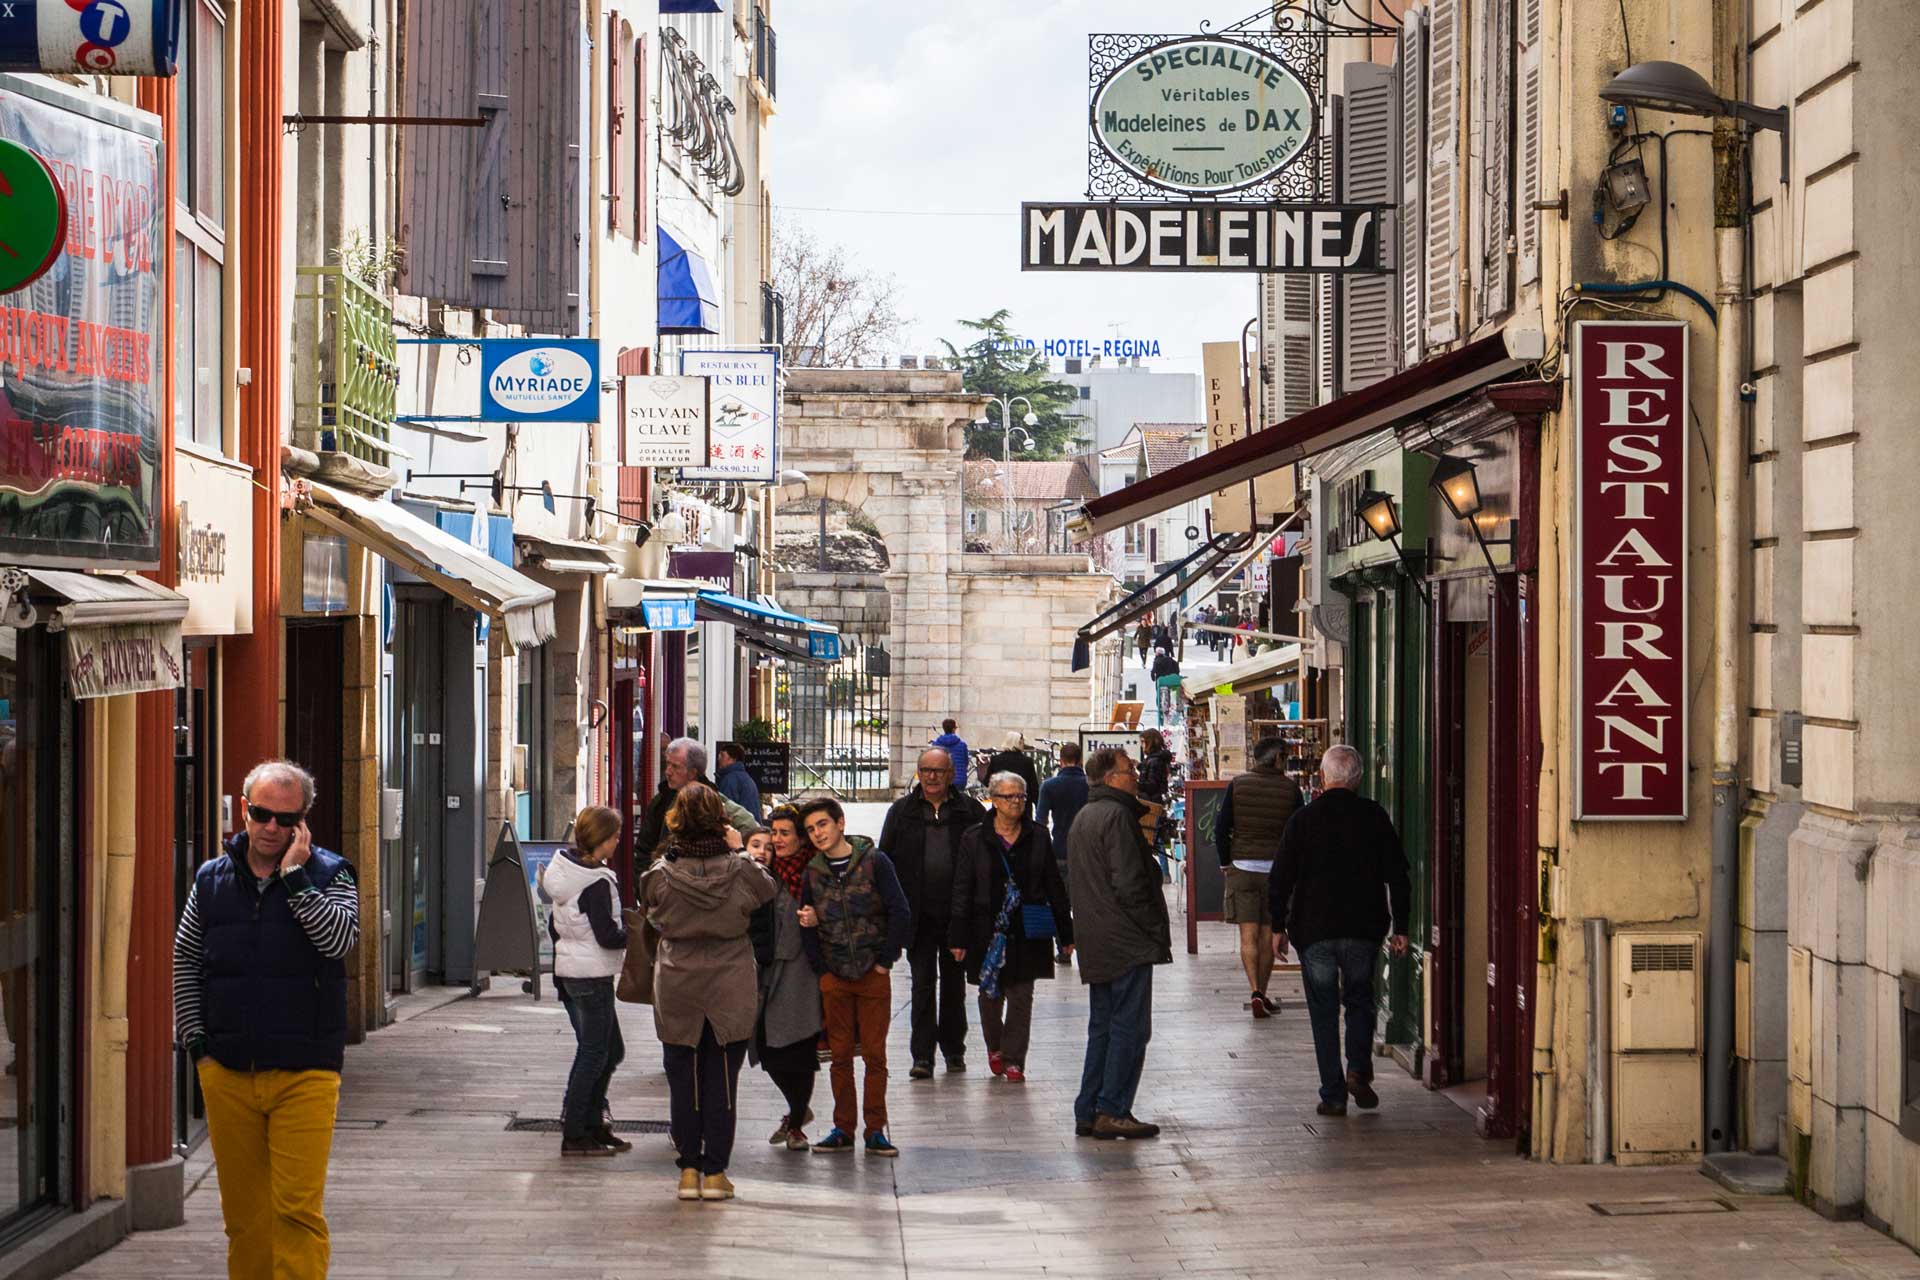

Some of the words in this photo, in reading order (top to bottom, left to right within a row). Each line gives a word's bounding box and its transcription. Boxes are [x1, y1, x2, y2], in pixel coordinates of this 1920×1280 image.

[1137, 46, 1284, 90] SPECIALITE
[1162, 88, 1250, 102] Véritables
[1104, 110, 1206, 132] Madeleines
[1219, 117, 1237, 132] de
[1245, 108, 1302, 132] DAX
[1117, 139, 1199, 185] Expéditions
[1205, 169, 1234, 185] Pour
[1235, 158, 1270, 181] Tous
[1265, 135, 1298, 165] Pays
[1029, 208, 1373, 267] MADELEINES
[700, 361, 758, 370] RESTAURANT
[494, 375, 584, 392] MYRIADE
[736, 374, 771, 387] BLEU
[506, 393, 545, 401] MUTUELLE
[630, 407, 700, 419] SYLVAIN
[638, 421, 692, 436] CLAVÉ
[1594, 341, 1675, 801] RESTAURANT
